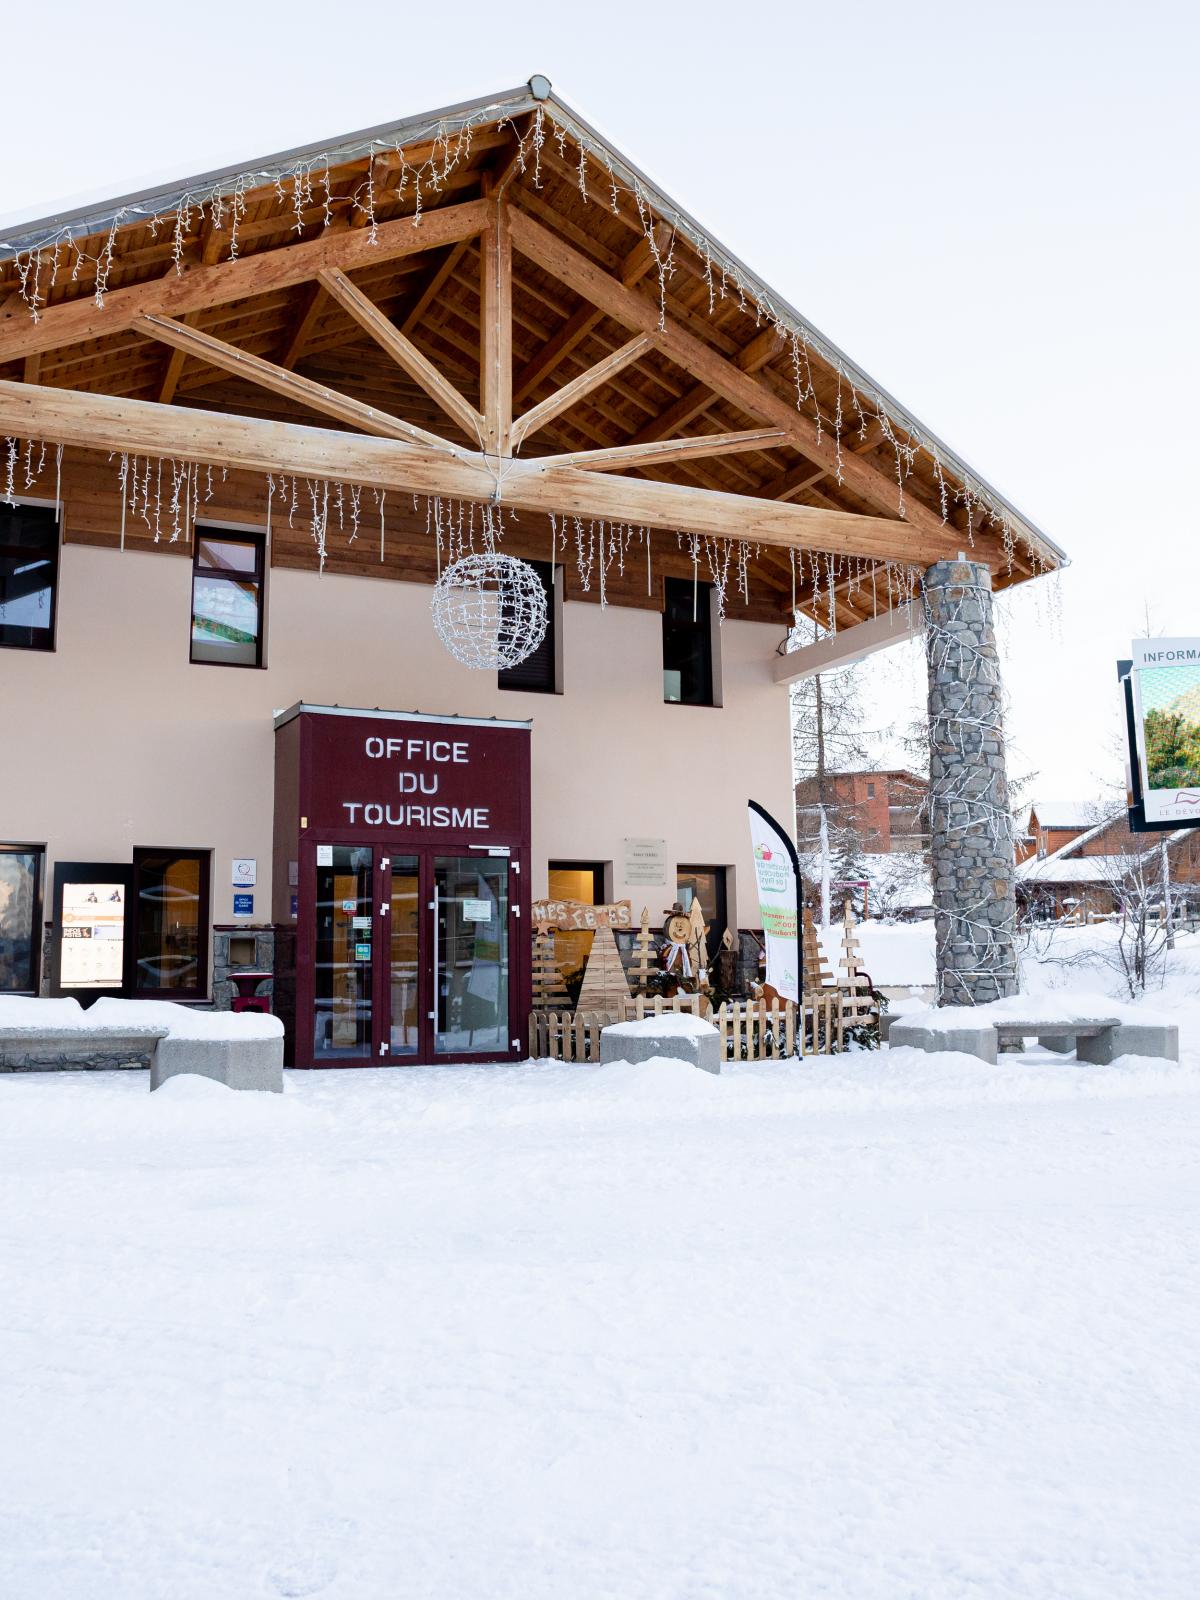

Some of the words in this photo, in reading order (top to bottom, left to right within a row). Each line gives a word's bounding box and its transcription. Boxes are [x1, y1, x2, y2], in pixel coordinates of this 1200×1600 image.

[365, 737, 470, 763] OFFICE
[399, 772, 439, 794] DU
[343, 802, 490, 829] TOURISME
